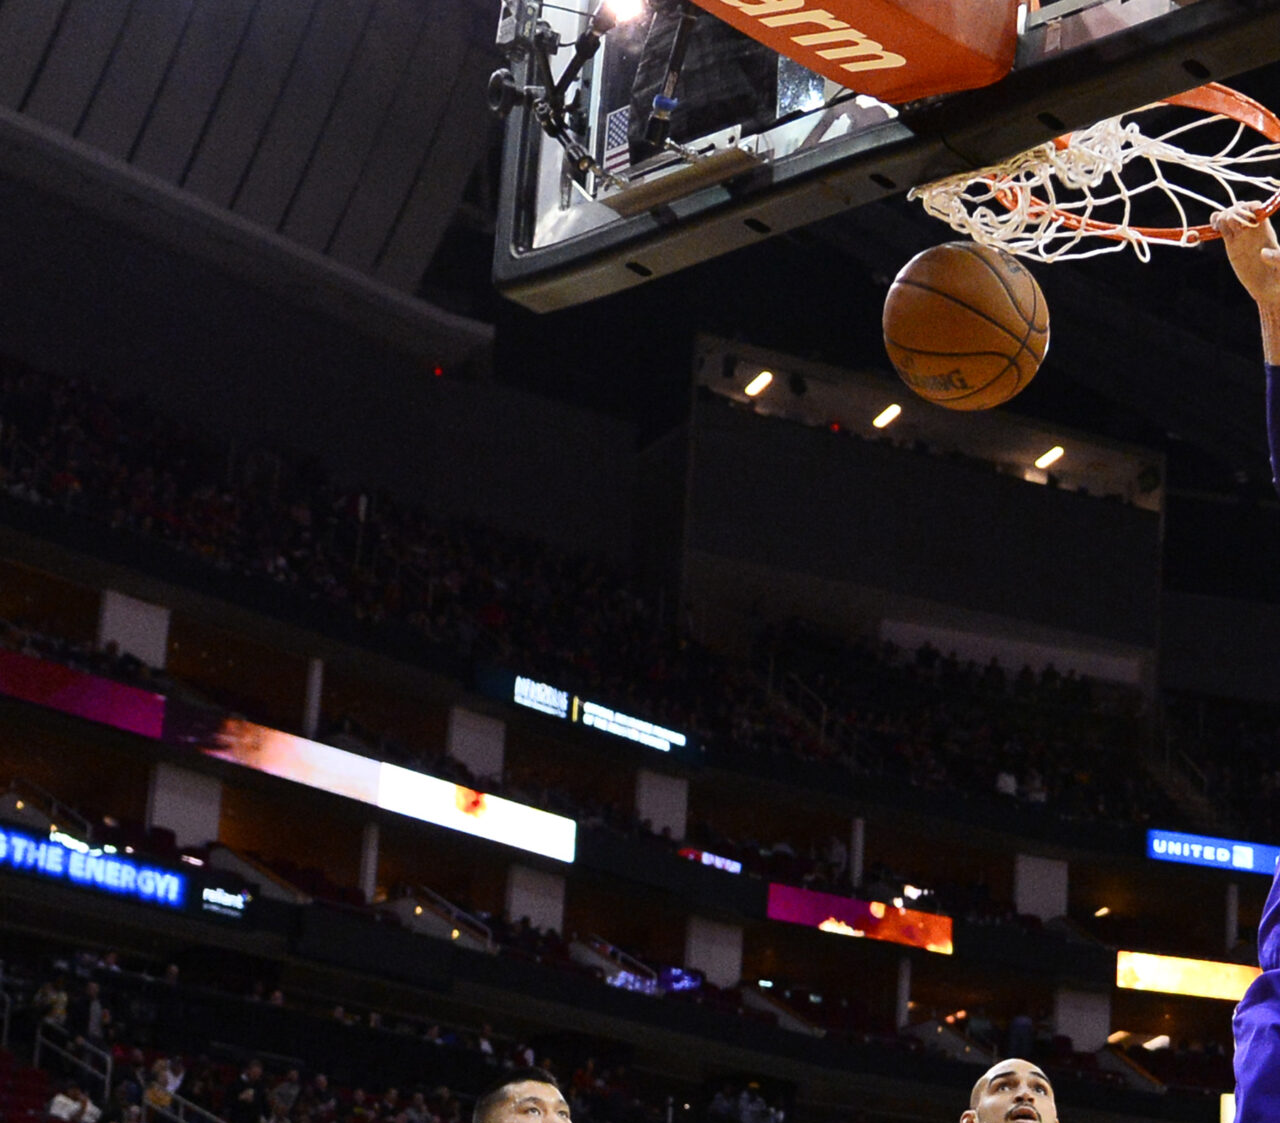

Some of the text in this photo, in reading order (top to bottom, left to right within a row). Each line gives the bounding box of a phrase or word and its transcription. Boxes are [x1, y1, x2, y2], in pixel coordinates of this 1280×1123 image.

[11, 835, 64, 873] THE
[69, 850, 180, 902] ENERGY!
[1152, 838, 1231, 862] UNITED
